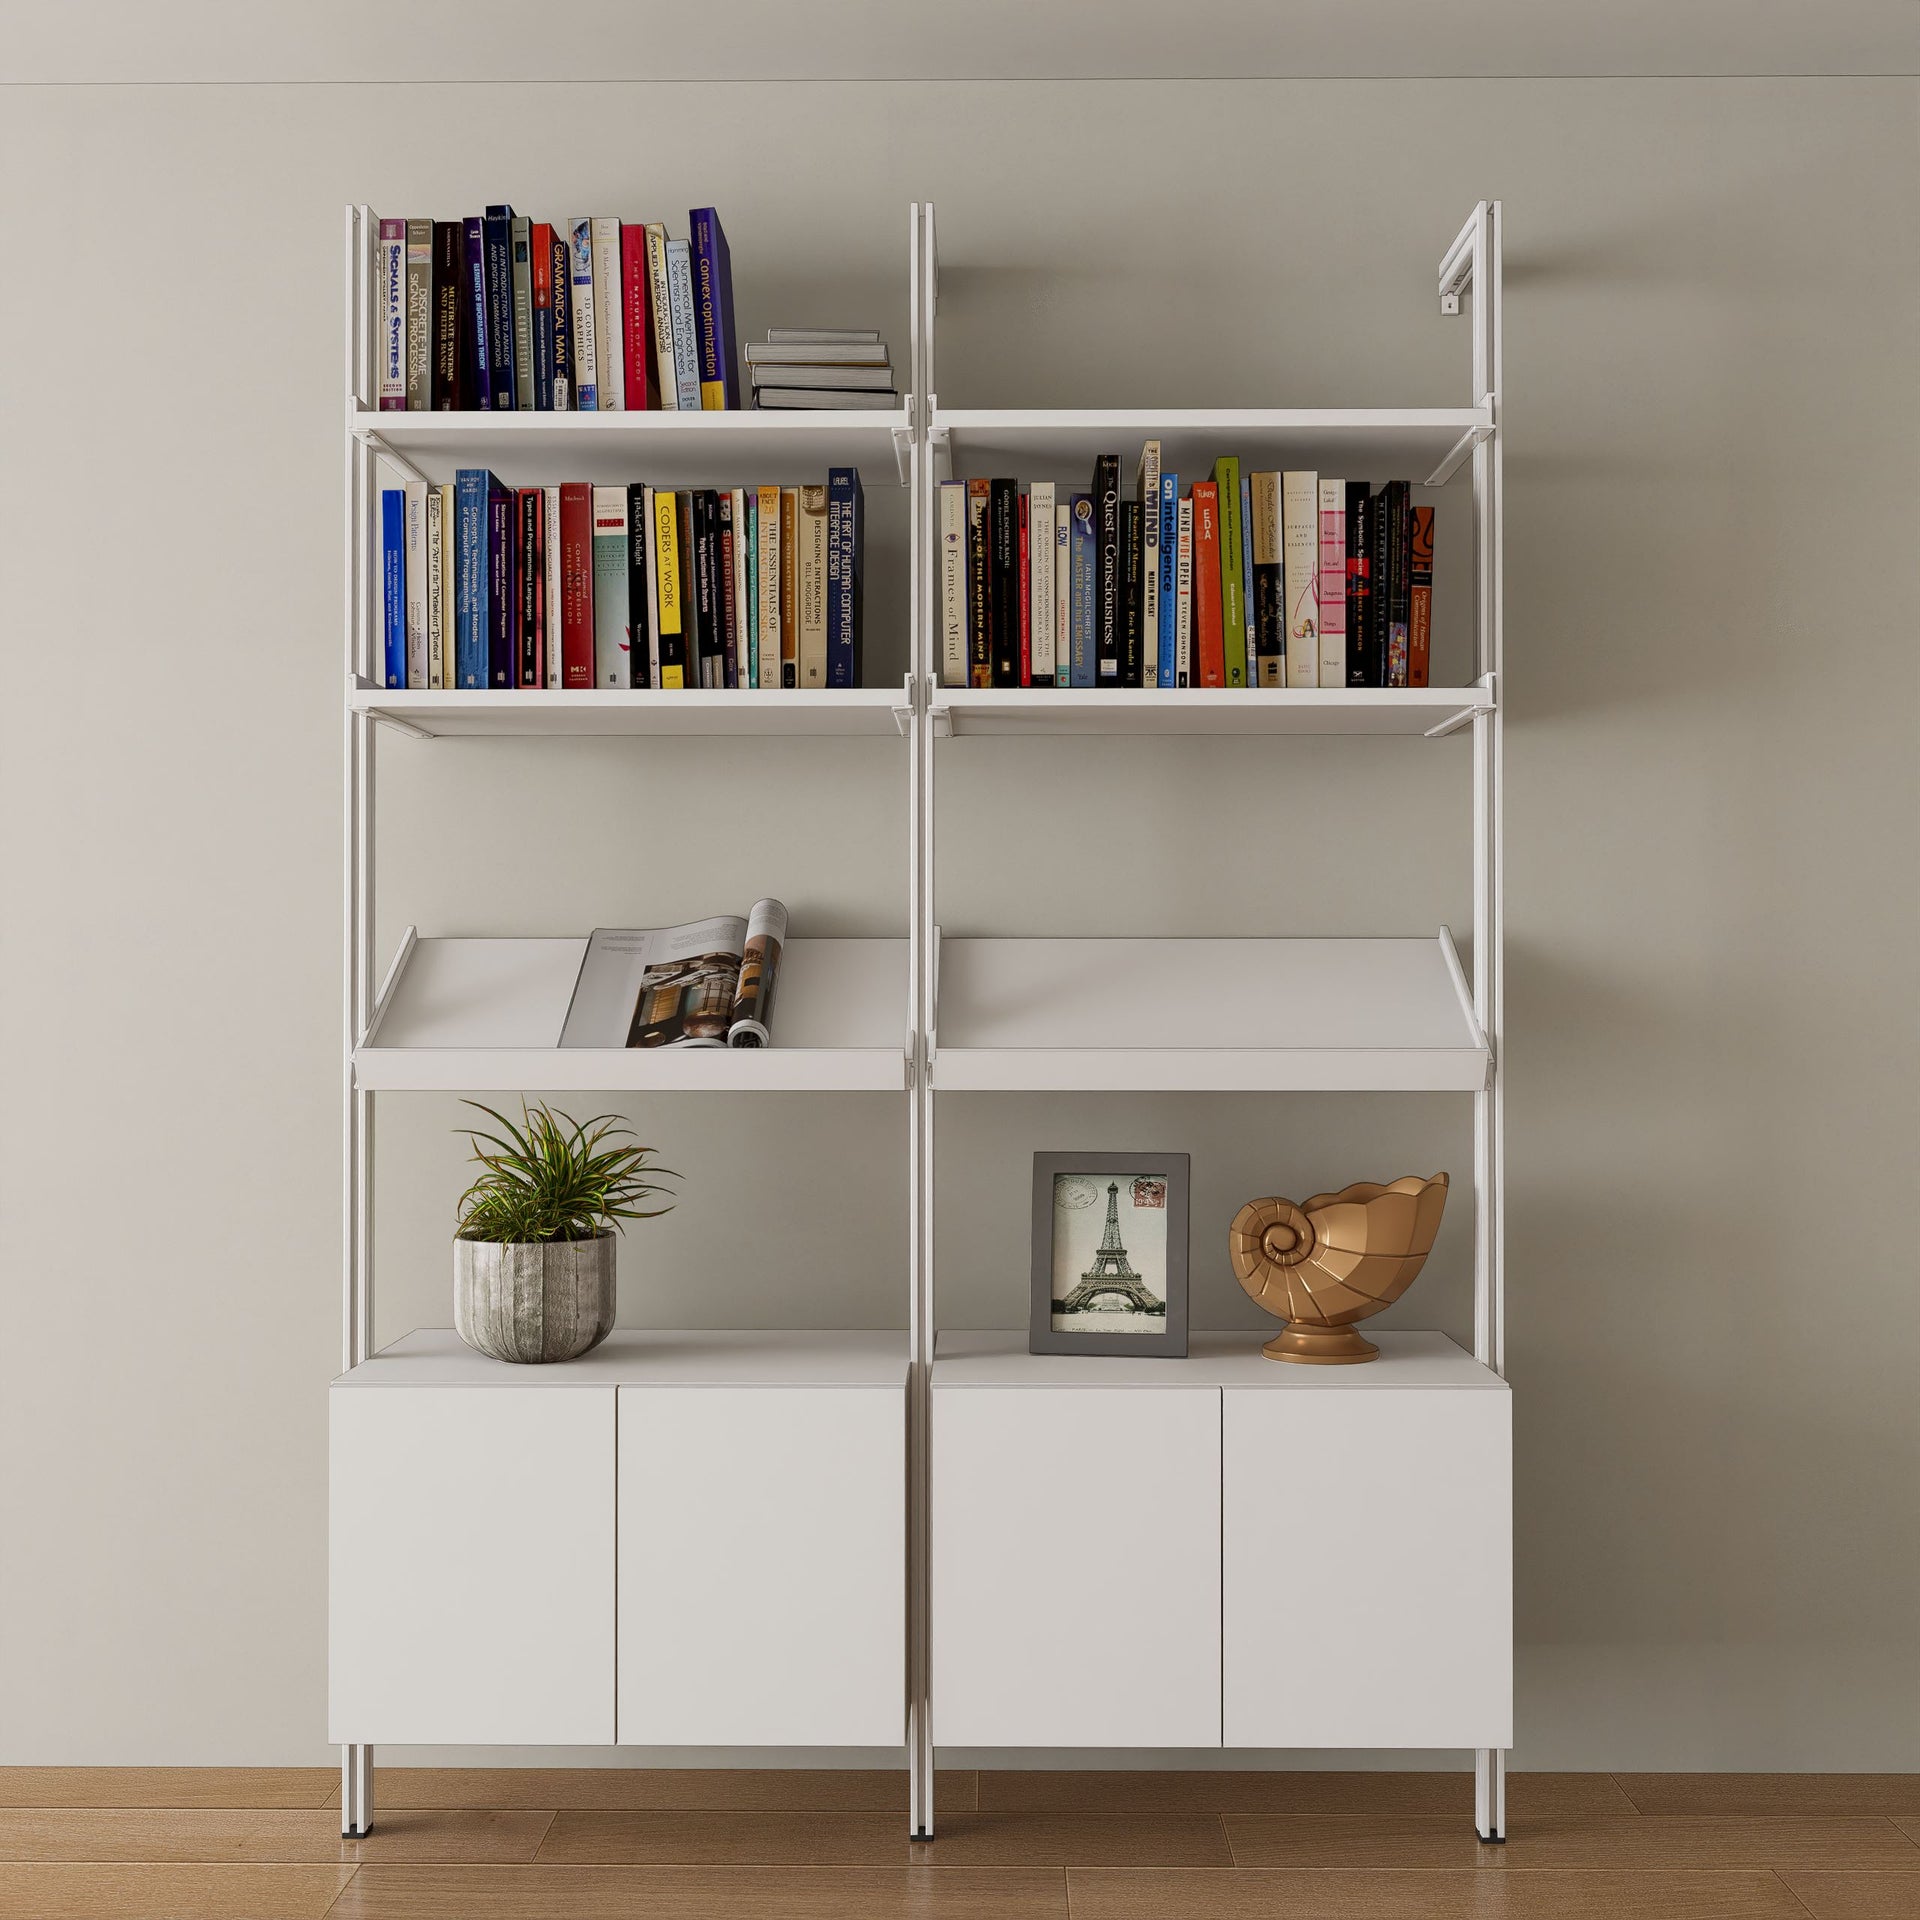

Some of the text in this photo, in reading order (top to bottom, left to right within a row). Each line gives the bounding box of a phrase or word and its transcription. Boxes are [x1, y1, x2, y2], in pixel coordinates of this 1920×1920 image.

[390, 245, 401, 302] SIGNALS
[499, 245, 506, 257] AN
[473, 263, 481, 292] ELEMENTS
[500, 258, 508, 318] INTRODUCTION
[554, 244, 565, 330] GRAMMATICAL
[650, 235, 666, 353] APPLIED NUMERICAL ANALYSIS
[410, 273, 418, 390] SIGNAL PROCESSING
[418, 288, 427, 374] DISCRETE-TIME
[475, 303, 484, 345] INFORMATION
[493, 294, 501, 367] COMMUNICATIONS
[503, 320, 509, 330] TO
[576, 309, 584, 361] GRAPHICS
[584, 297, 593, 372] 3D COMPUTER
[660, 281, 672, 352] INTRODUCTION TO
[672, 260, 686, 375] Scientists and Engineers
[681, 260, 696, 373] Numerical Methods for
[700, 259, 716, 376] Convex Optimization
[390, 317, 401, 378] SYSTEMS
[556, 335, 565, 364] MAN
[635, 334, 640, 346] OF
[410, 500, 419, 522] Design
[463, 507, 469, 515] of
[1104, 490, 1116, 531] Quest
[1164, 479, 1174, 499] on
[830, 501, 840, 547] INTERFACE
[1058, 526, 1068, 546] FLOW
[1146, 490, 1158, 548] MIND
[634, 535, 643, 565] Delight
[660, 506, 674, 608] CODERS AT WORK
[830, 551, 840, 580] DESIGN
[976, 546, 984, 558] OF
[1075, 537, 1083, 552] The
[1132, 541, 1139, 550] of
[1162, 501, 1175, 592] intelligence
[1180, 508, 1191, 585] MIND WIDE OPEN
[723, 530, 733, 648] SUPERDISTRIBUTION
[841, 501, 852, 644] THE ART OF HUMAN-COMPUTER
[1037, 566, 1042, 576] OF
[1044, 565, 1049, 573] OF
[948, 549, 959, 661] Frames of Mind
[1076, 609, 1084, 621] his
[1104, 544, 1116, 644] Consciousness
[769, 617, 777, 633] OF
[1075, 624, 1083, 668] EMISSARY
[1128, 629, 1134, 637] R.
[1379, 631, 1384, 643] BY
